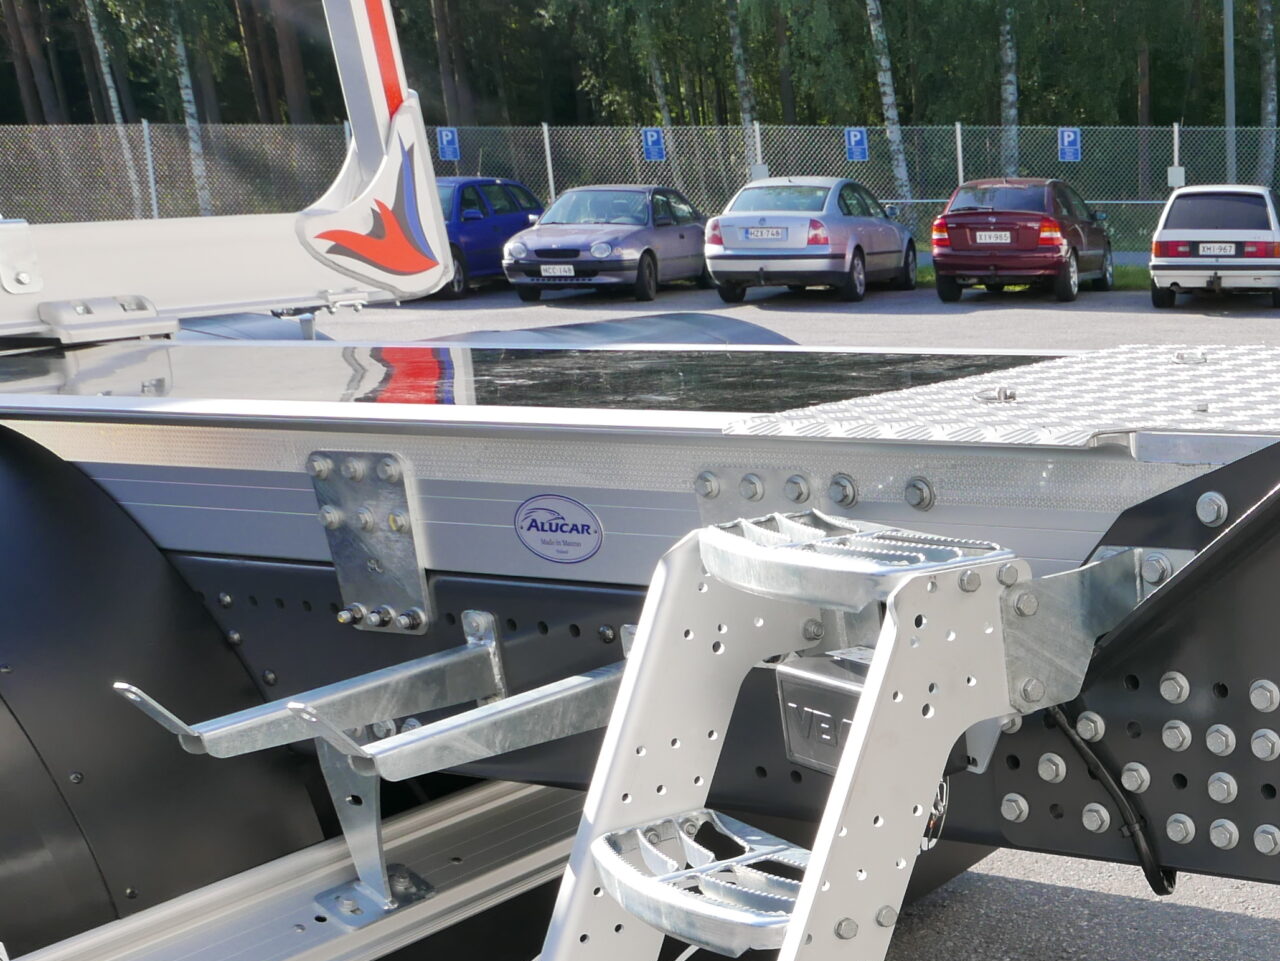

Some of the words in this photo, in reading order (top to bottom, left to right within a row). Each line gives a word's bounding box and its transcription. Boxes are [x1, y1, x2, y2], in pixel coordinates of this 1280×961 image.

[442, 131, 452, 145] P
[647, 131, 658, 146] P
[850, 131, 861, 146] P
[1063, 131, 1075, 146] P
[527, 519, 592, 535] ALUCAR
